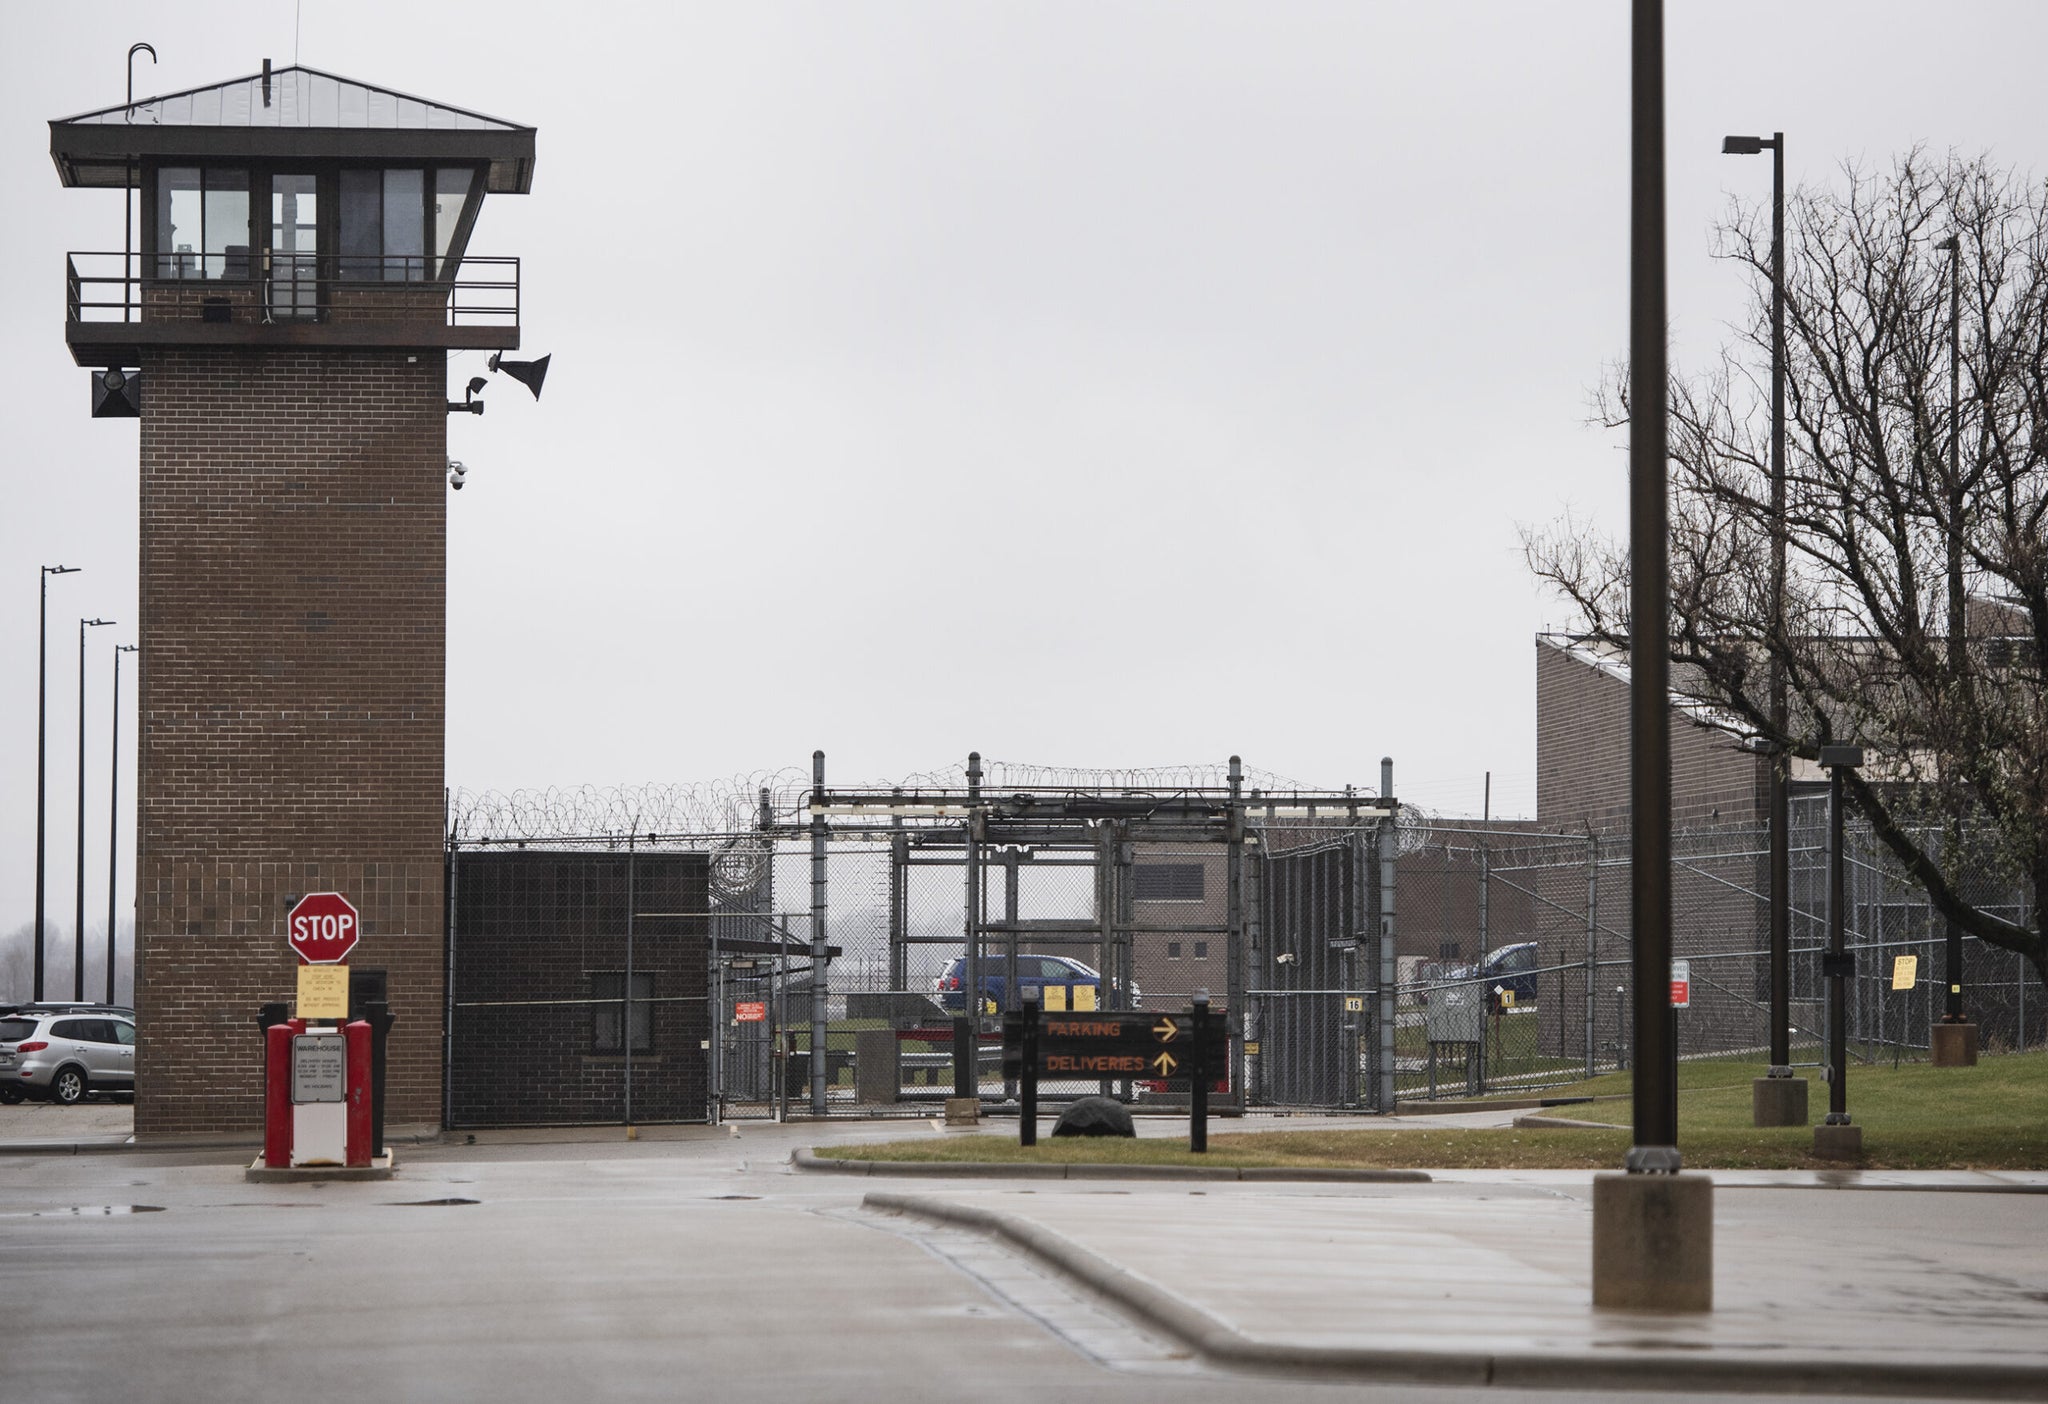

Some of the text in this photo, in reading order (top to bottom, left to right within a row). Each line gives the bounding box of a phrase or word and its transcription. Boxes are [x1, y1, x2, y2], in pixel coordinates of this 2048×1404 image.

[294, 914, 353, 941] STOP
[1350, 1000, 1359, 1010] 16
[1047, 1021, 1121, 1036] PARKING
[1047, 1055, 1145, 1071] DELIVERIES
